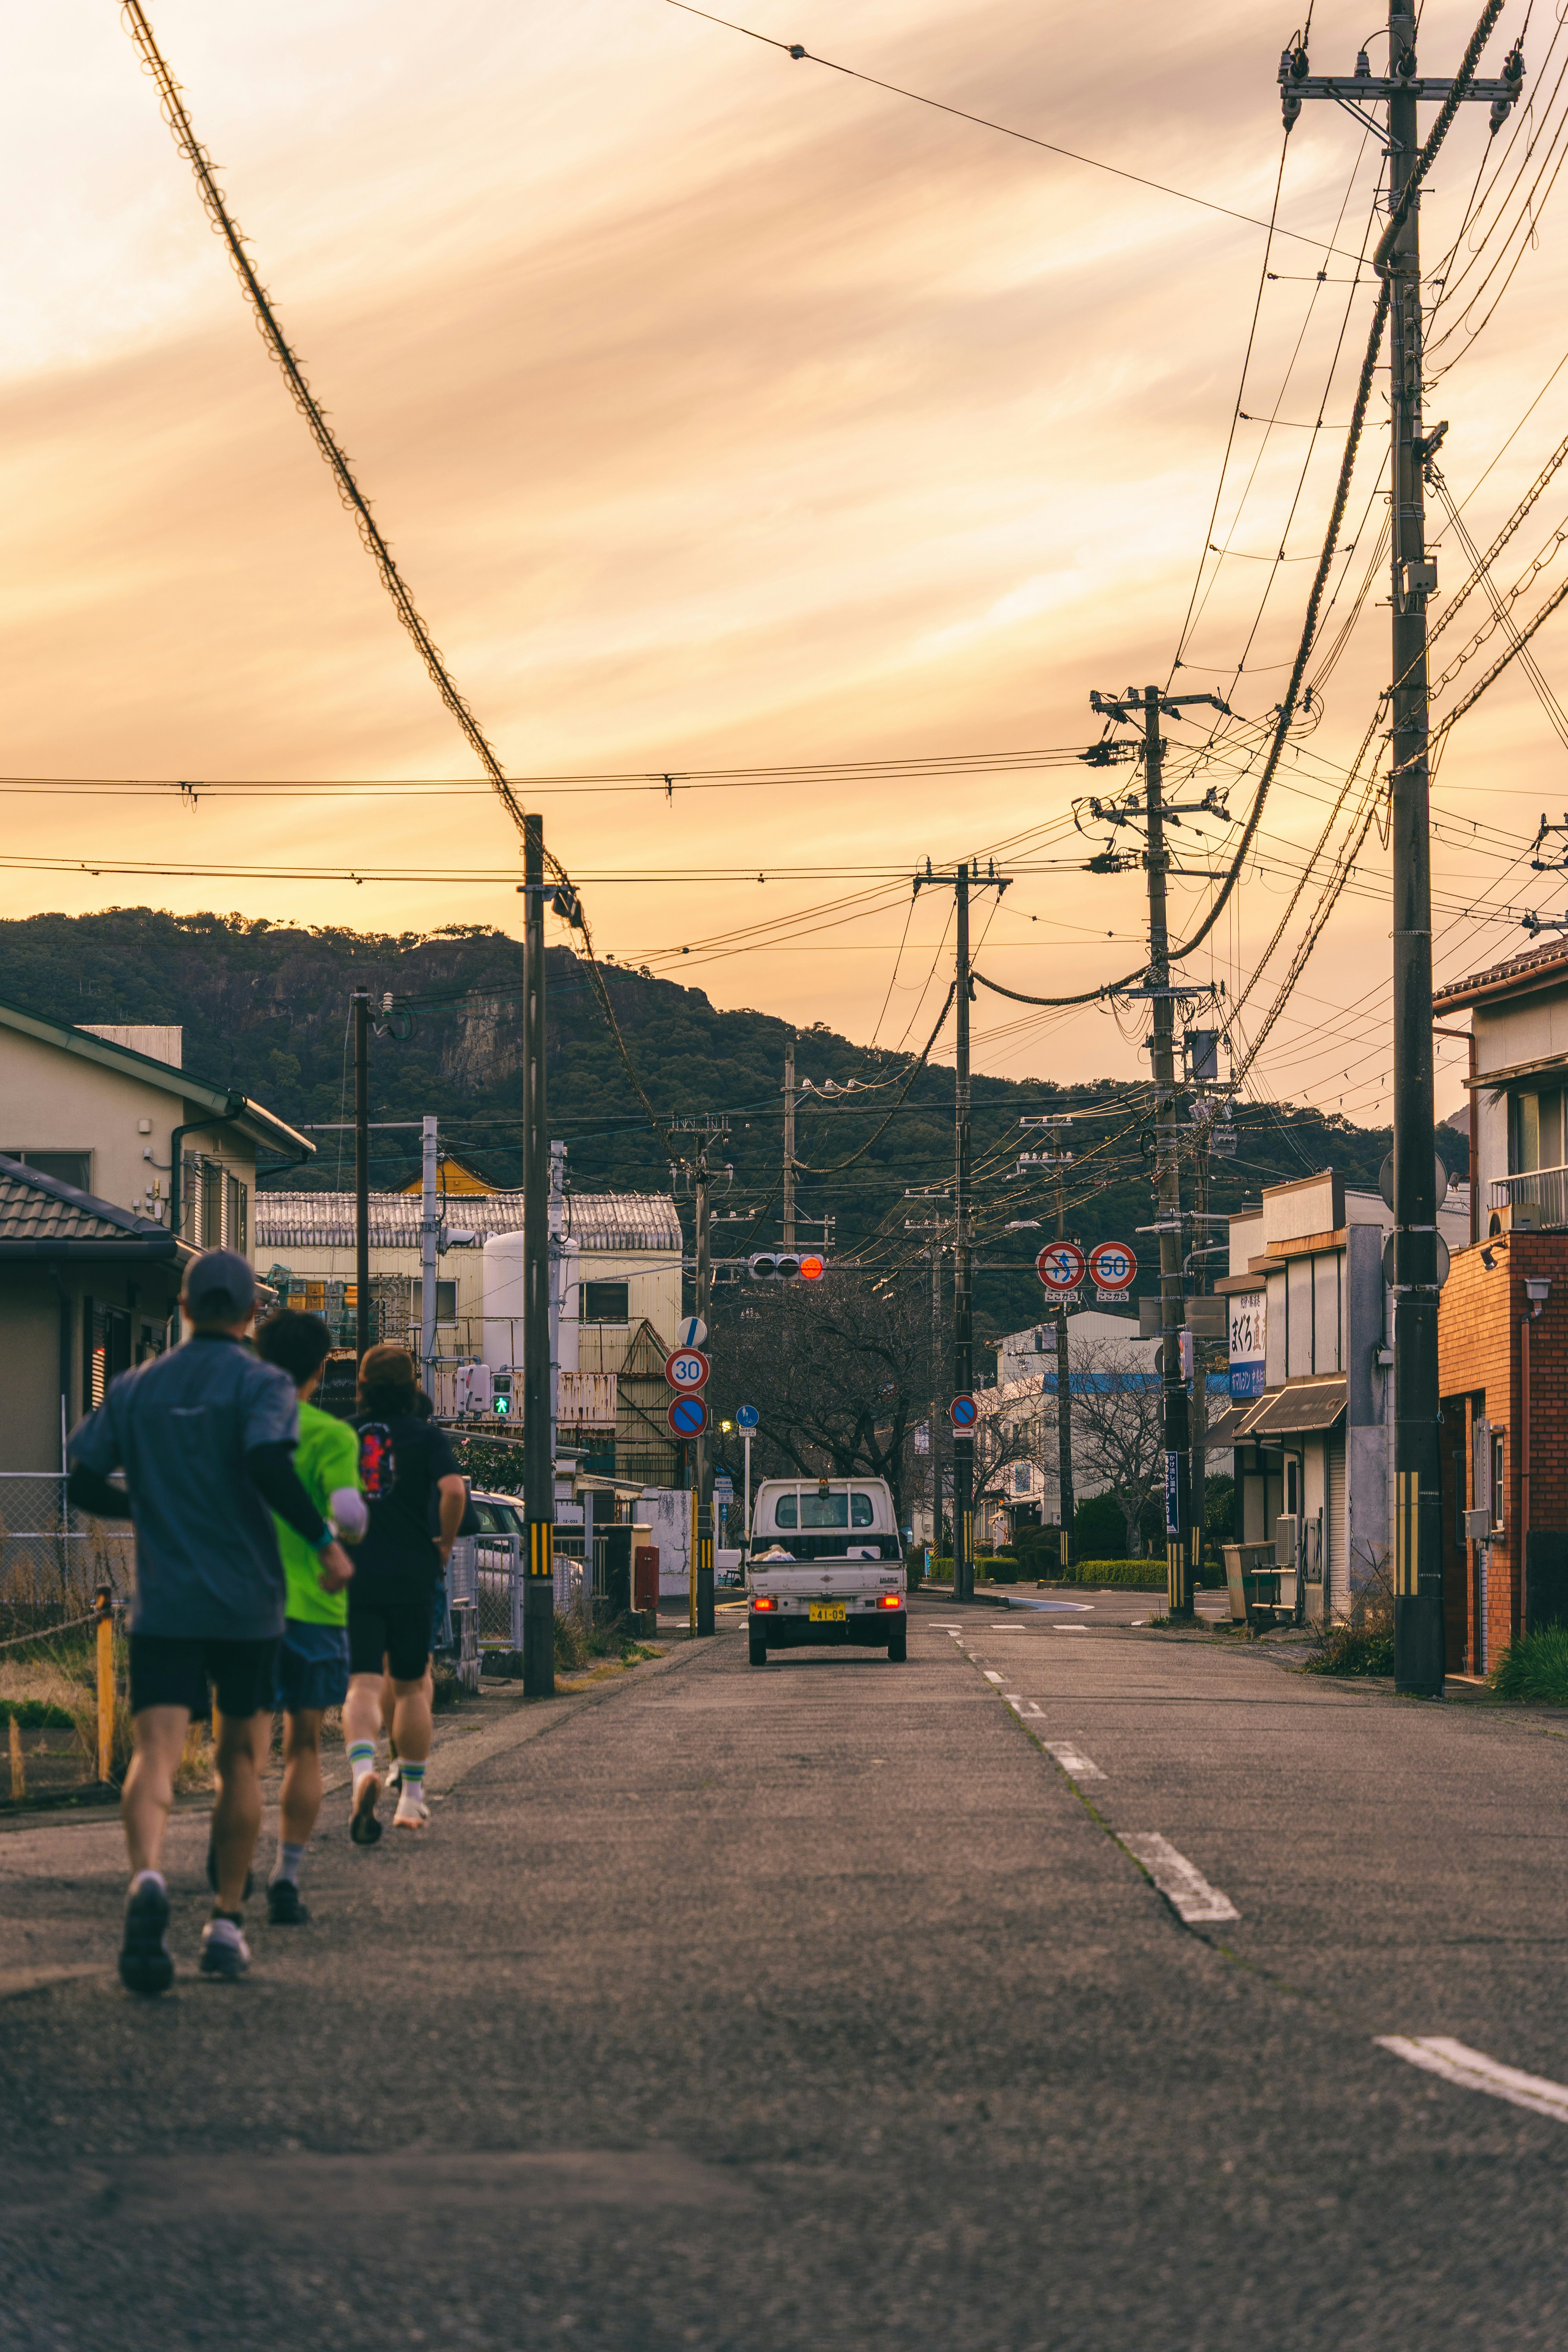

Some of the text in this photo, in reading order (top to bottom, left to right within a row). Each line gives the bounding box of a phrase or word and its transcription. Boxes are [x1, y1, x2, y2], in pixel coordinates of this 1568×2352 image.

[1101, 1256, 1125, 1276] 50
[675, 1361, 699, 1380] 30
[817, 1610, 844, 1619] 41-09
